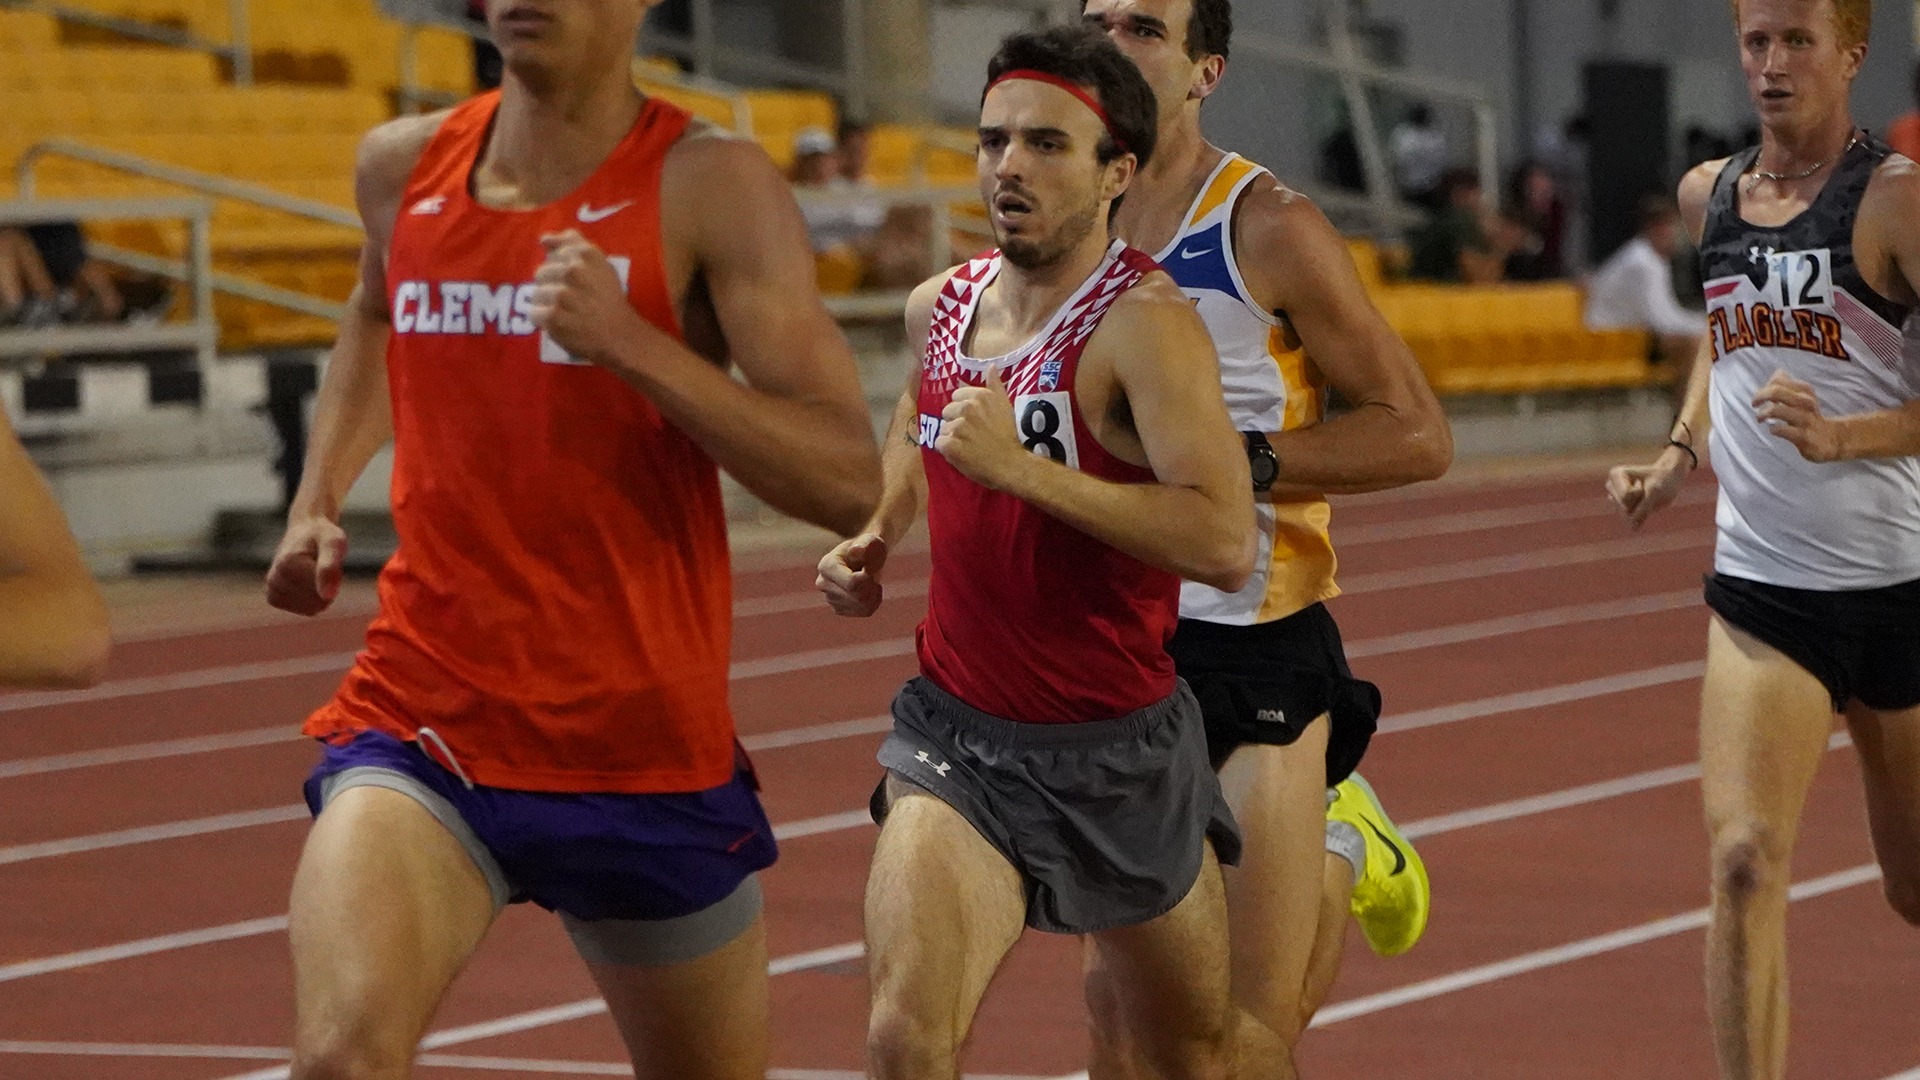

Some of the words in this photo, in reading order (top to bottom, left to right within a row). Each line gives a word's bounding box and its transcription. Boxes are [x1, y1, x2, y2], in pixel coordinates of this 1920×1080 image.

[1772, 254, 1824, 307] 12
[394, 281, 538, 335] CLEMS
[920, 413, 945, 449] SO
[1021, 400, 1067, 466] 8
[1257, 709, 1286, 723] BOA
